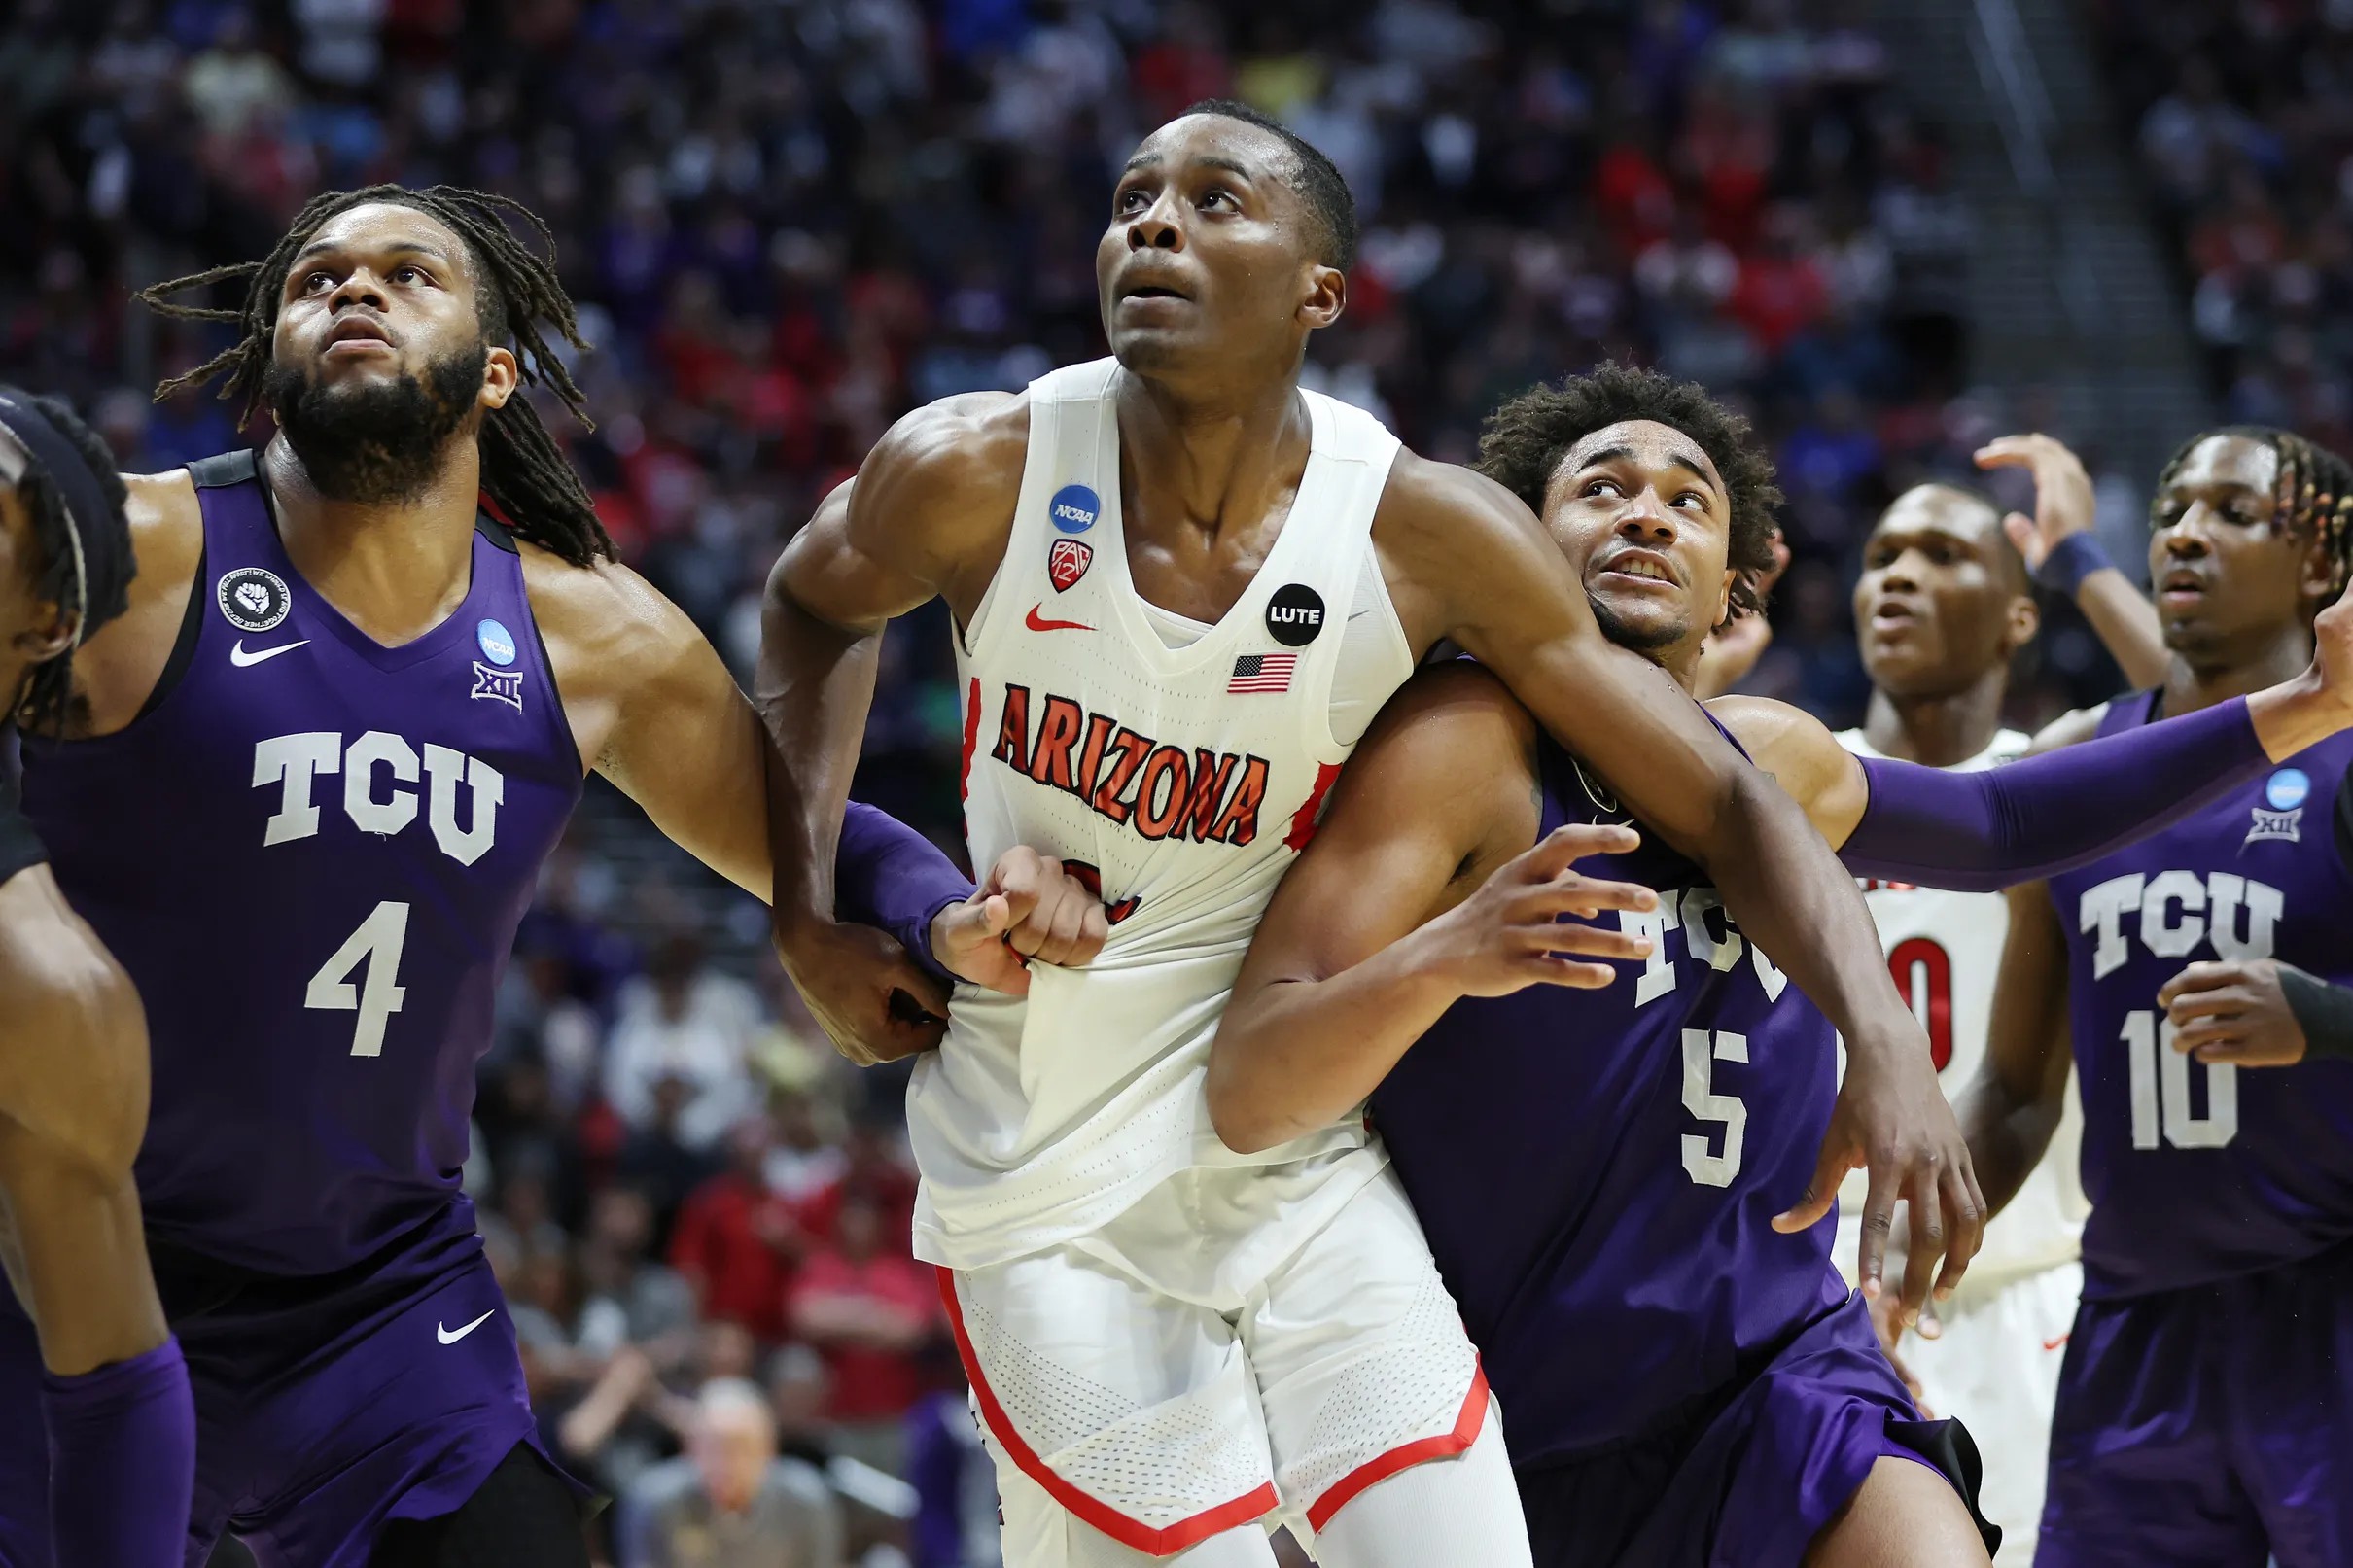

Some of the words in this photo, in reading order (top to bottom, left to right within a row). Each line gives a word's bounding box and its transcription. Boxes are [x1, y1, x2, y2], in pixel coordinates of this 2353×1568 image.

[1051, 541, 1092, 575] PAC
[1054, 504, 1095, 525] NCAA
[1053, 562, 1072, 582] 12
[1270, 606, 1321, 625] LUTE
[482, 637, 514, 658] NCAA
[251, 730, 504, 867] TCU
[991, 682, 1271, 847] ARIZONA
[303, 900, 410, 1057] 4
[2080, 869, 2284, 982] TCU
[1681, 1028, 1749, 1188] 5
[2119, 1009, 2238, 1150] 10
